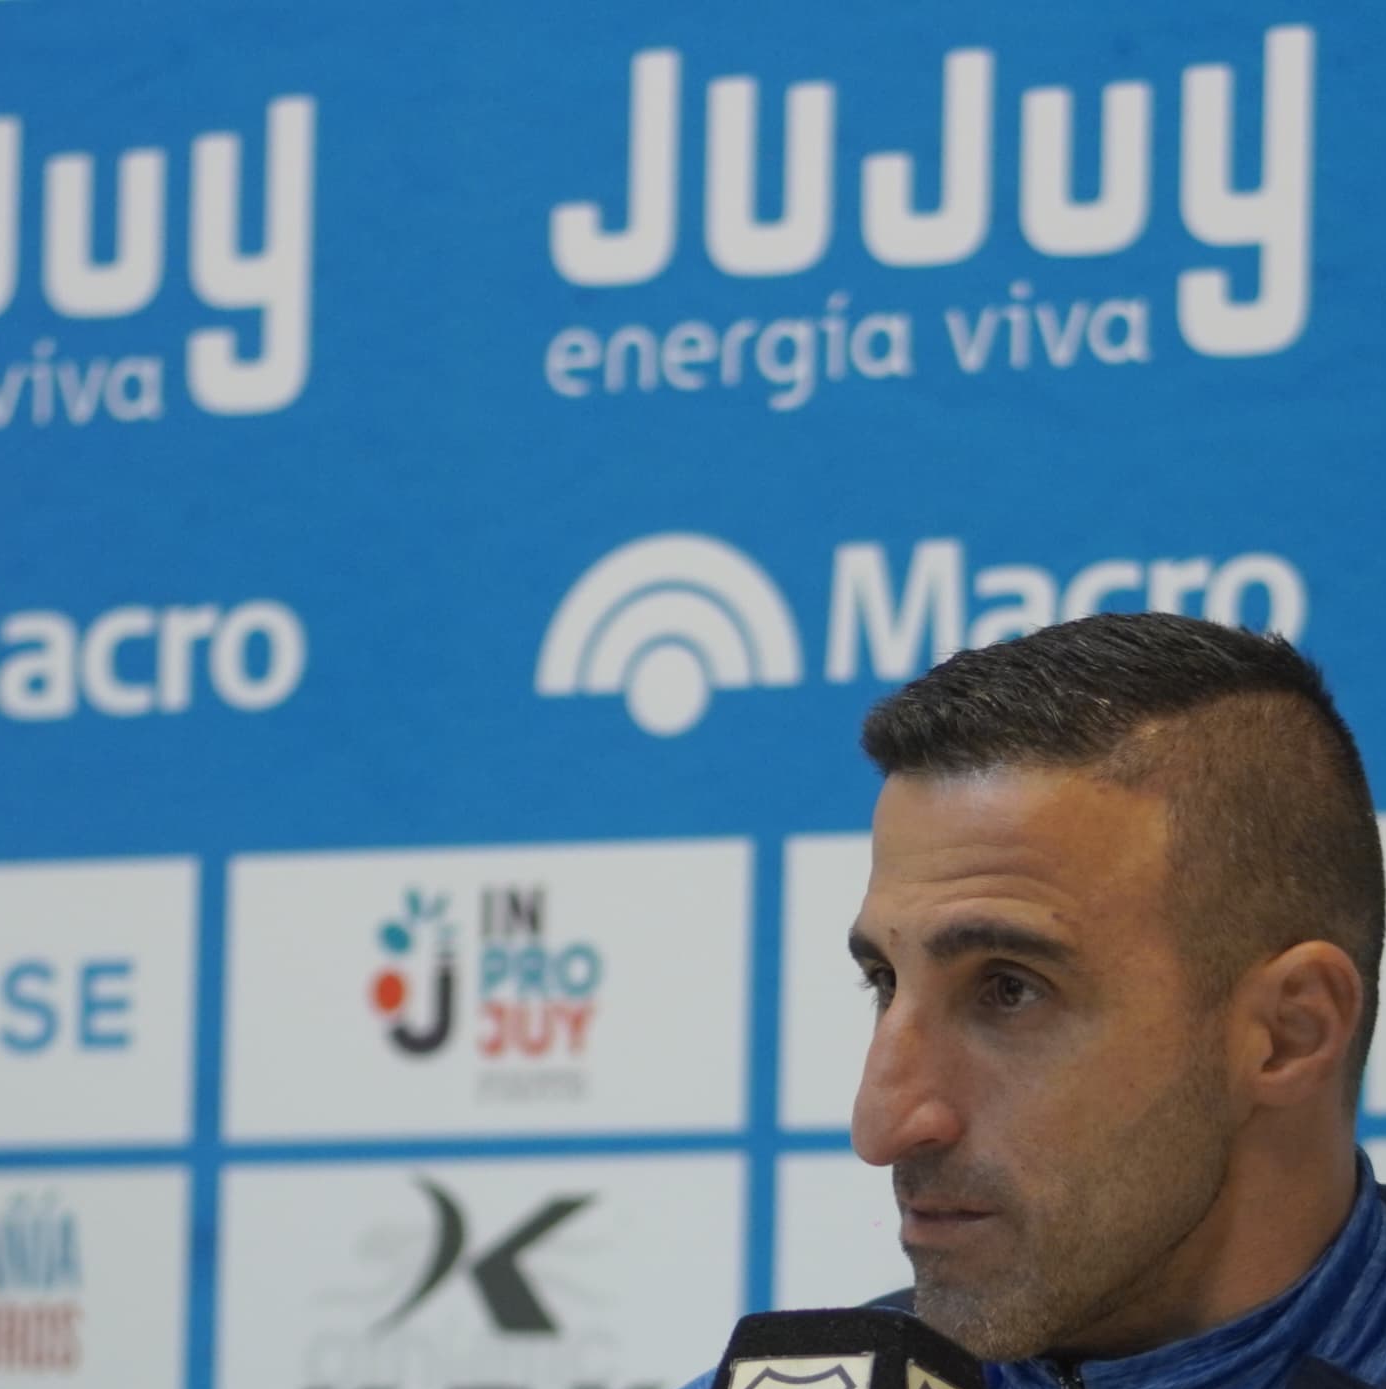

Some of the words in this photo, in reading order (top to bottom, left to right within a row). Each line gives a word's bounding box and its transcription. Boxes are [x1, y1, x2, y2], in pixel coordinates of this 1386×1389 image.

[544, 292, 911, 411] energía
[947, 281, 1150, 373] viva
[480, 888, 545, 936] IN
[480, 945, 601, 997] PRO
[477, 1004, 593, 1057] JUY
